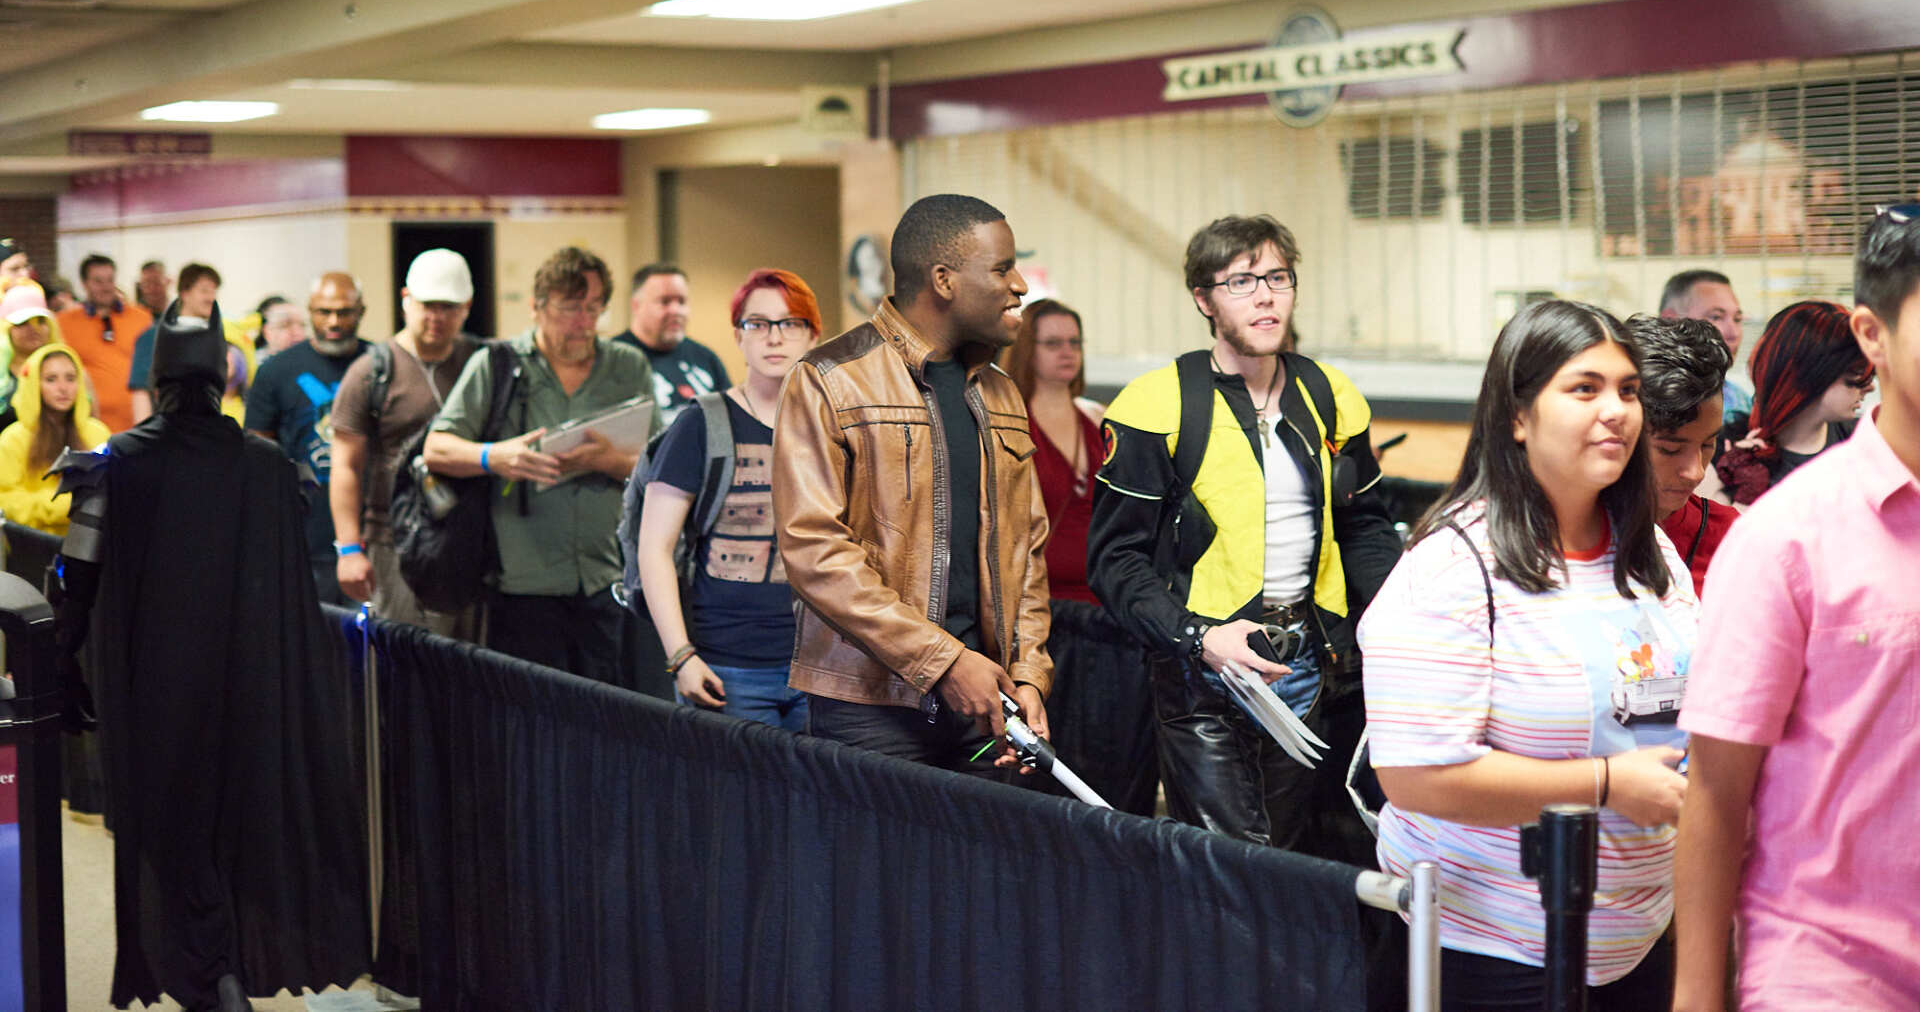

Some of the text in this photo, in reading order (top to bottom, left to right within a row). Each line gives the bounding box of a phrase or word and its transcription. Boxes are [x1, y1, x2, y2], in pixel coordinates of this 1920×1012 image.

[1177, 41, 1437, 90] CAPITAL CLASSICS
[0, 774, 15, 784] er
